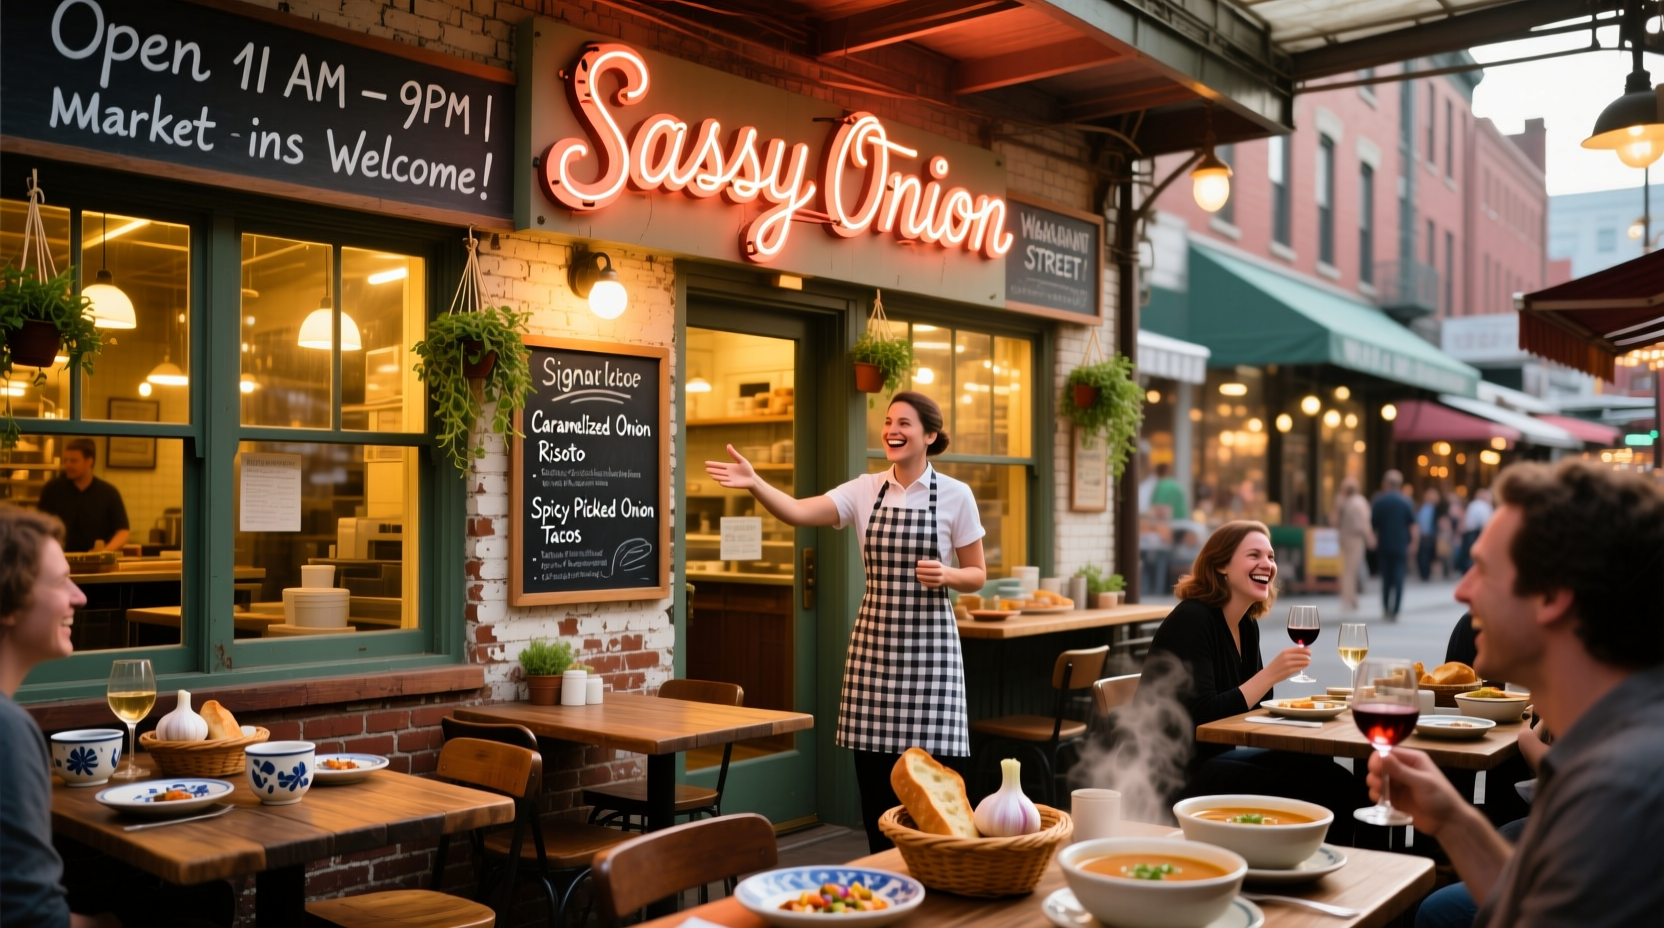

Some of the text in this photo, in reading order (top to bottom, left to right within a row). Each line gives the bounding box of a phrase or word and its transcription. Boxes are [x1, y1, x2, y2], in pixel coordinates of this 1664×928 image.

[51, 0, 211, 88] Open
[283, 53, 346, 109] AM
[399, 80, 470, 136] 9PM
[49, 86, 217, 152] Market
[326, 129, 494, 201] Welcome!
[545, 43, 1014, 263] Sassy Onion
[538, 439, 586, 463] Risoto
[531, 496, 655, 526] Spicy Picked Onion
[540, 525, 582, 545] Tacos
